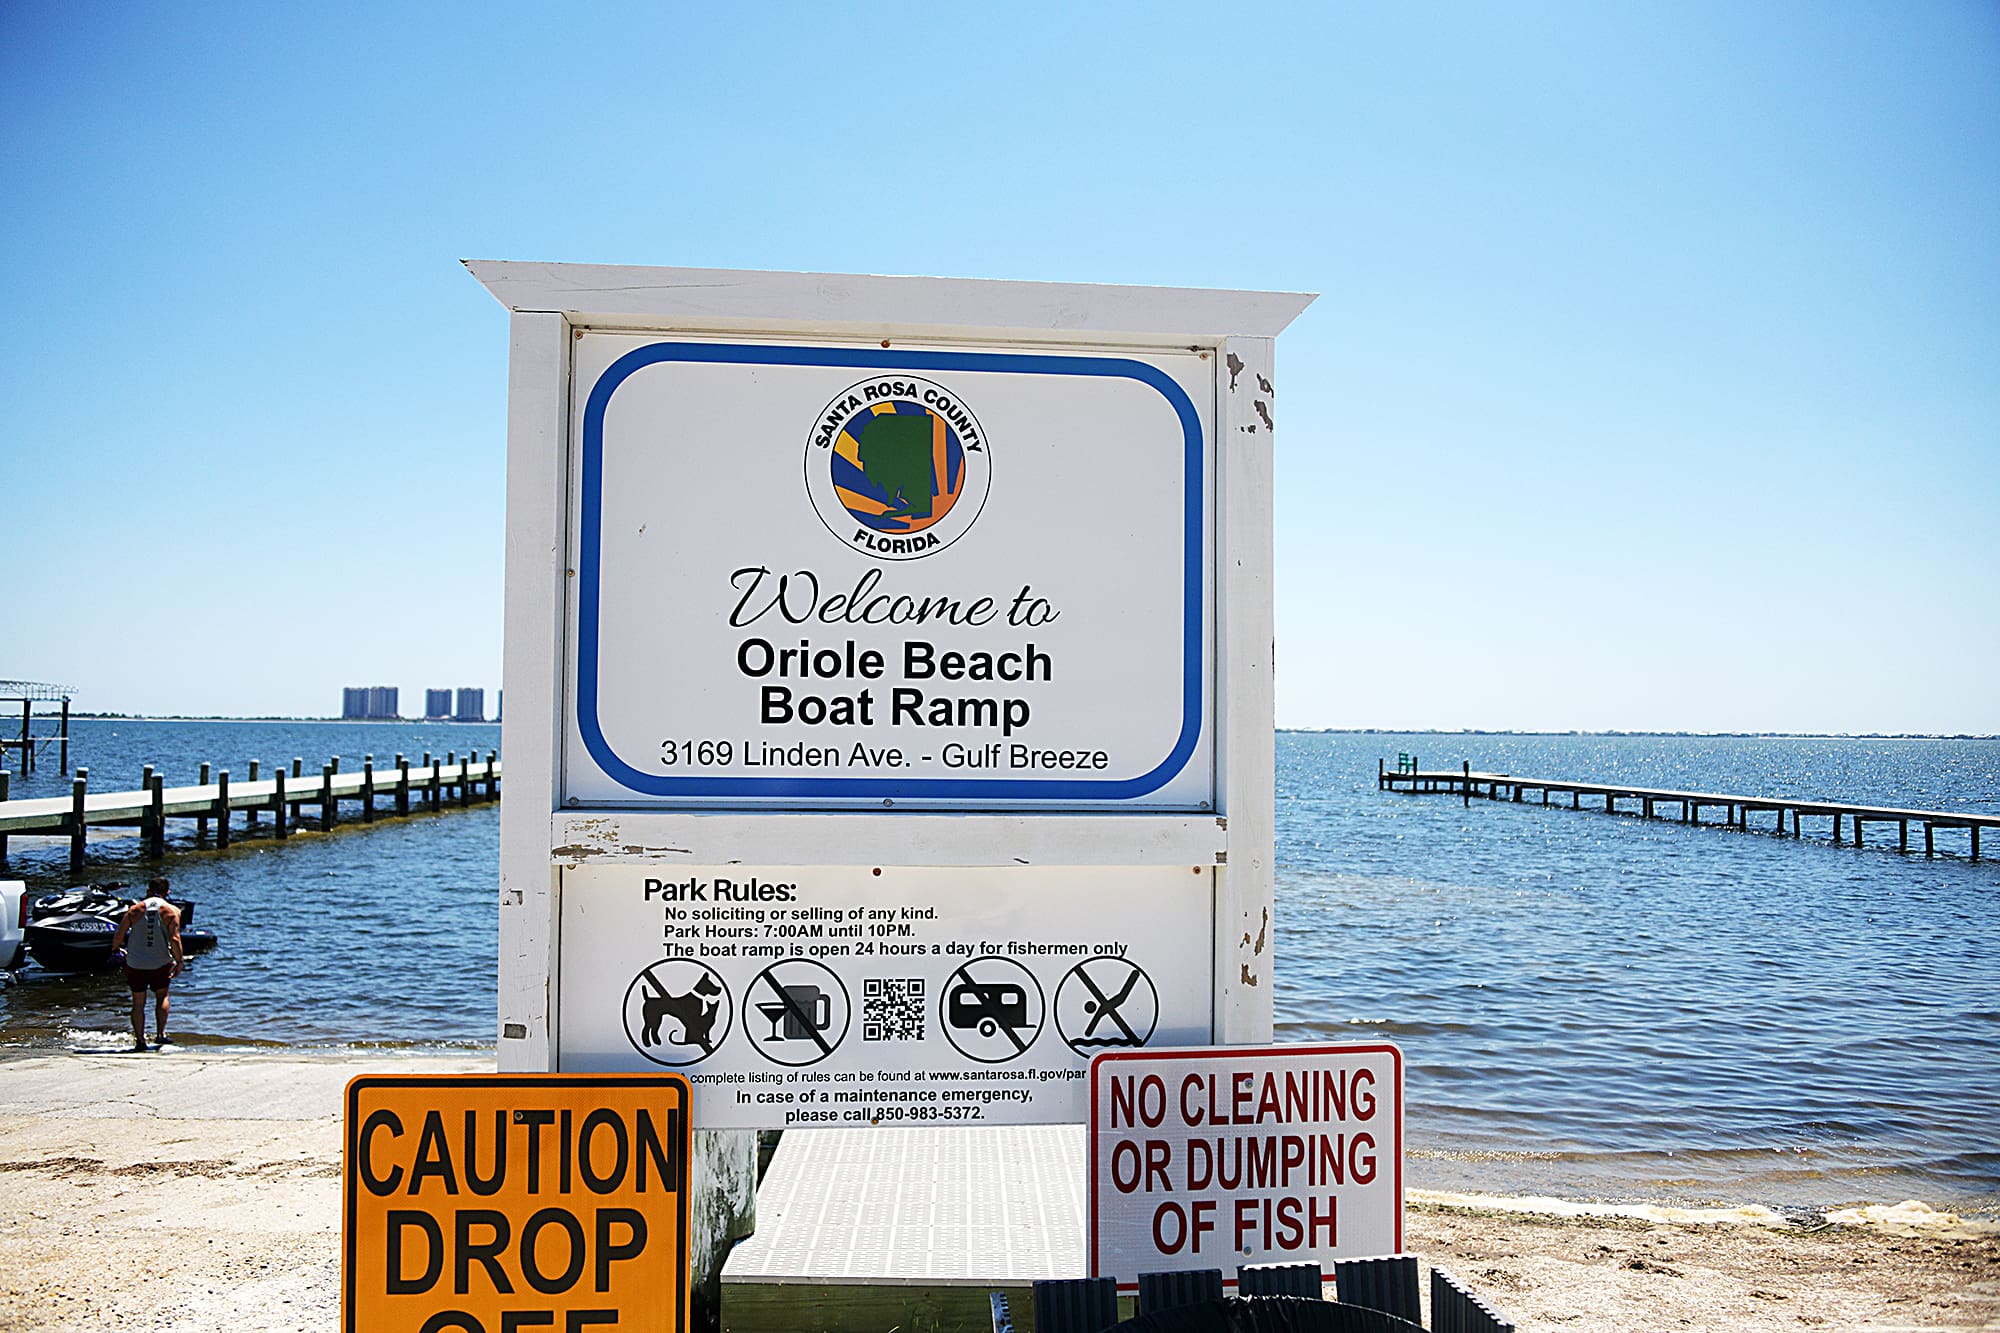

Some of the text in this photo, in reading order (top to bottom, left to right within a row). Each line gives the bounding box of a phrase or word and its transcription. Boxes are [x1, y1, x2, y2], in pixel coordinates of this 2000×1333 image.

[815, 381, 983, 453] SANTA ROSA COUNTY
[853, 528, 941, 554] FLORIDA
[729, 564, 1061, 628] Welcome to
[737, 638, 1052, 682] Oriole Beach
[761, 685, 1030, 737] Boat Ramp
[661, 740, 733, 766] 3169
[744, 741, 840, 767] Linden
[847, 742, 911, 768] Ave.
[942, 743, 1002, 769] Gulf
[1010, 743, 1109, 770] Breeze
[644, 877, 797, 902] Park Rules:
[664, 923, 915, 938] Park Hours: 7:00AM until 10PM.
[665, 906, 938, 924] No soliciting or selling of any kind.
[662, 940, 1129, 960] The boat ramp is open 24 hours a day for fishermen only
[689, 1072, 746, 1086] complete
[748, 1071, 783, 1086] listing
[786, 1071, 799, 1083] of
[801, 1071, 831, 1083] rules
[833, 1072, 856, 1082] can
[859, 1070, 875, 1082] be
[877, 1070, 911, 1082] found
[914, 1070, 926, 1082] at
[736, 1088, 1033, 1104] In case of a maintenance emergency,
[785, 1106, 985, 1125] please call 850-983-5372.
[1111, 1068, 1376, 1129] NO CLEANING
[358, 1107, 678, 1198] CAUTION
[1111, 1132, 1377, 1194] OR DUMPING
[1152, 1195, 1337, 1256] OF FISH
[386, 1207, 648, 1296] DROP
